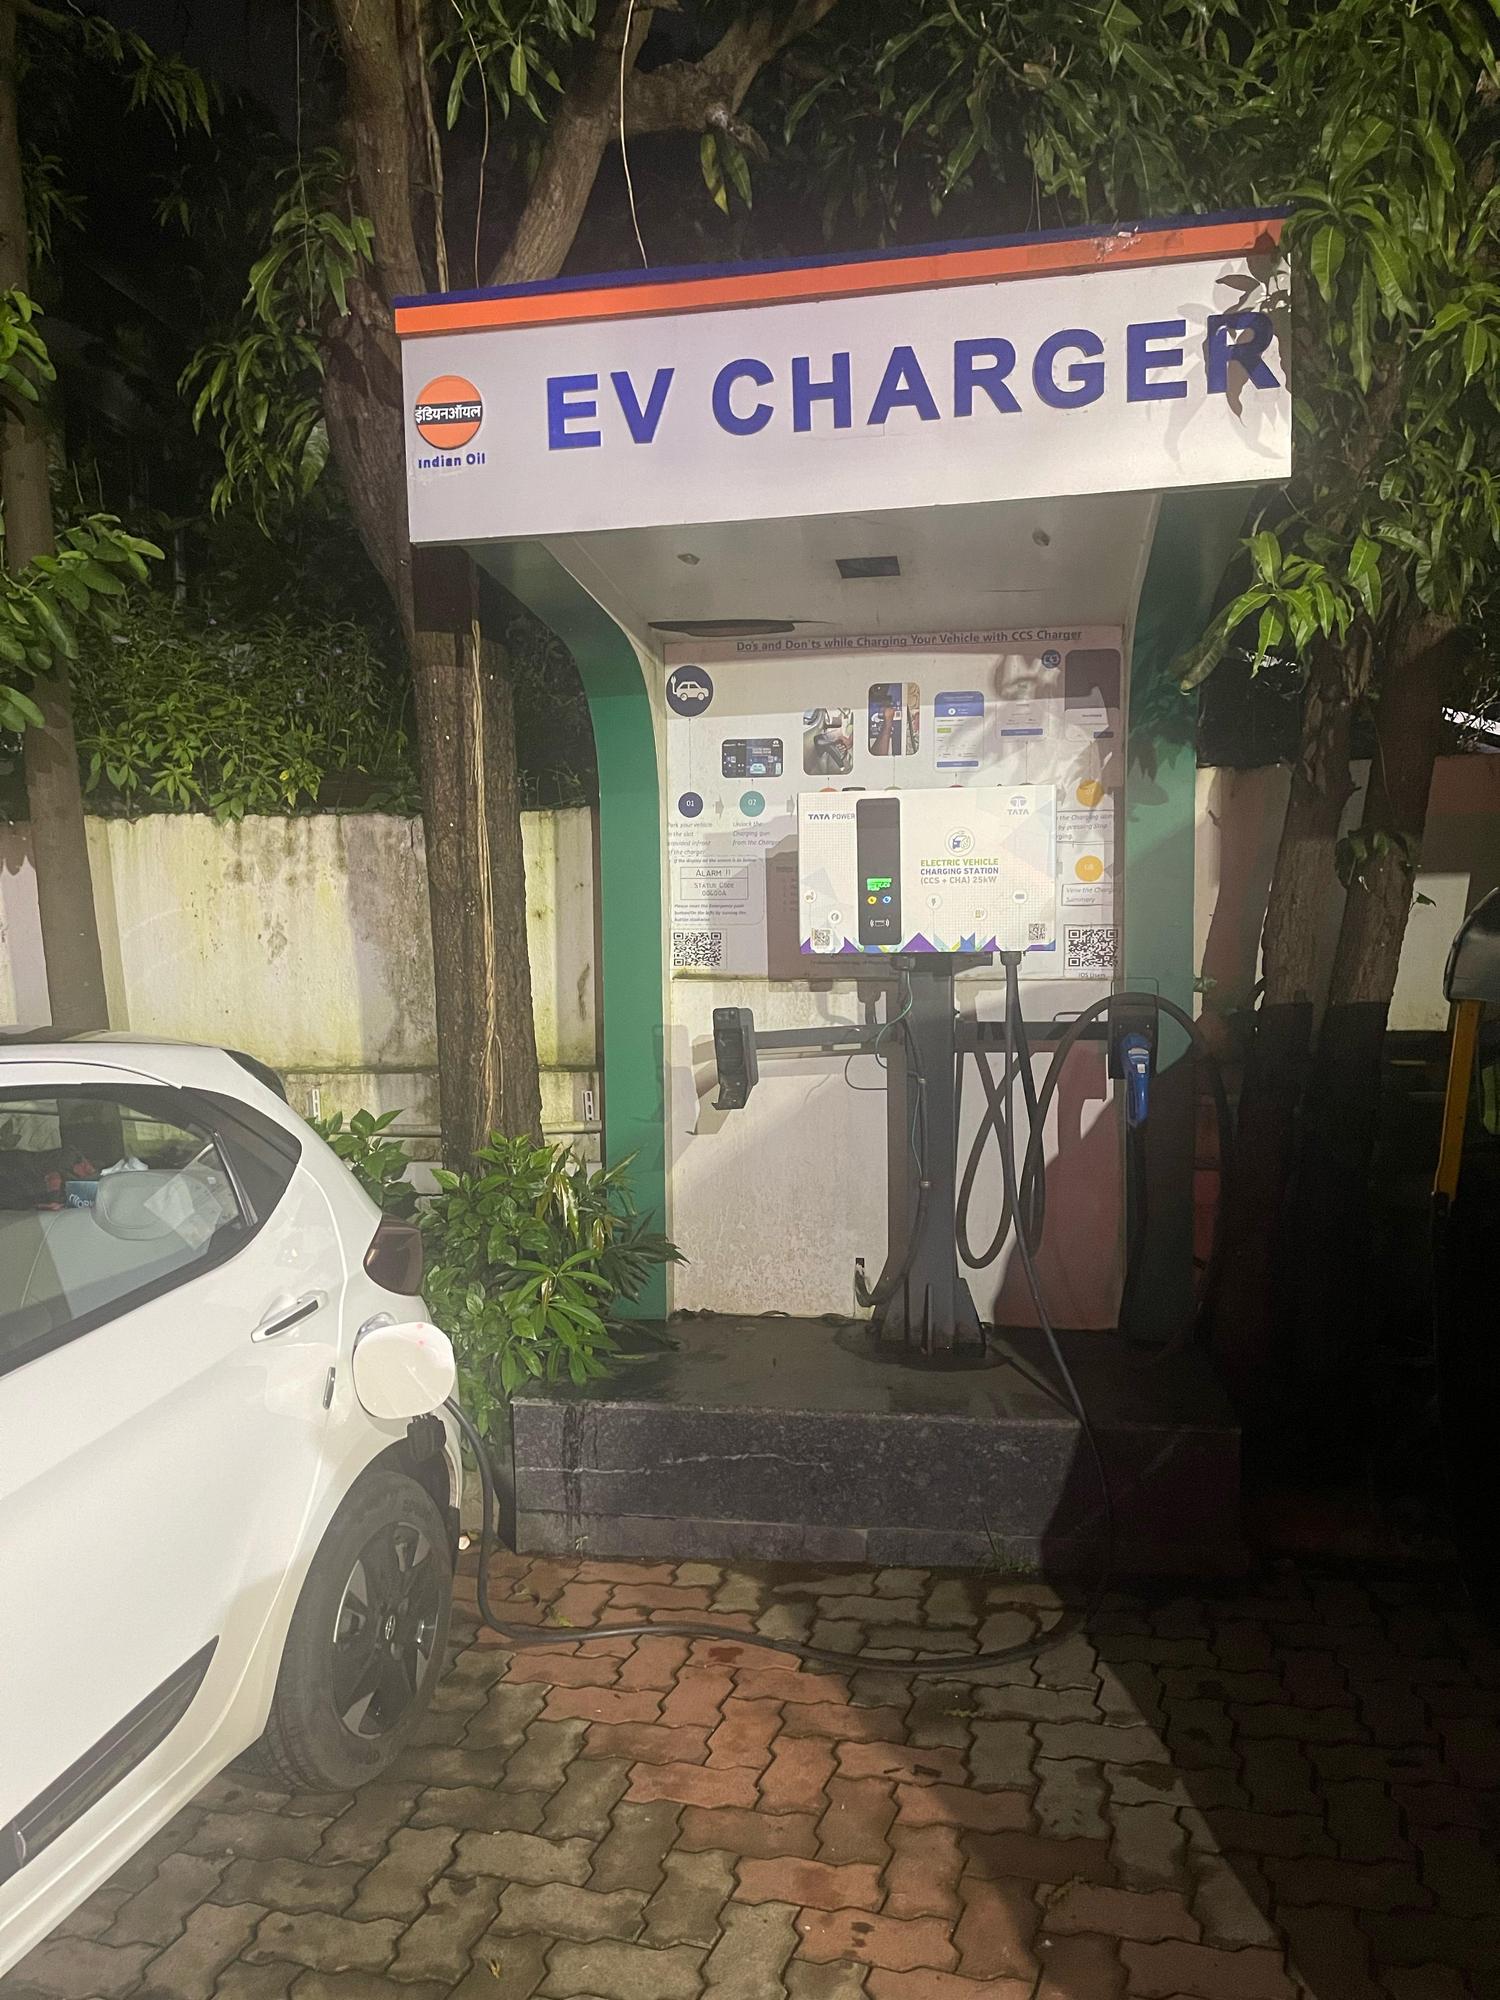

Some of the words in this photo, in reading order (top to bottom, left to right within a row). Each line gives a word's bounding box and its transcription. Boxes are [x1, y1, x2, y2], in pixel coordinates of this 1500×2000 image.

[547, 368, 675, 451] EV
[712, 311, 1281, 436] CHARGER
[415, 404, 481, 423] इंडियनऑयल
[418, 455, 462, 468] Indian
[466, 452, 485, 464] Oil
[736, 641, 758, 651] Do's
[762, 640, 781, 650] and
[785, 639, 821, 649] Don'ts
[824, 636, 853, 648] while
[856, 635, 907, 647] Charging
[911, 634, 936, 645] Your
[940, 632, 979, 643] Vehicle
[983, 631, 1008, 642] with
[1011, 631, 1033, 641] CCS
[1037, 630, 1082, 641] Charger
[831, 812, 855, 820] POWER
[920, 858, 960, 867] ELECTRIC
[963, 858, 999, 866] VEHICLE
[920, 867, 962, 875] CHARGING
[964, 867, 999, 875] STATION
[920, 877, 940, 886] (CCS
[949, 876, 970, 885] CHA)
[973, 876, 998, 885] 25kW
